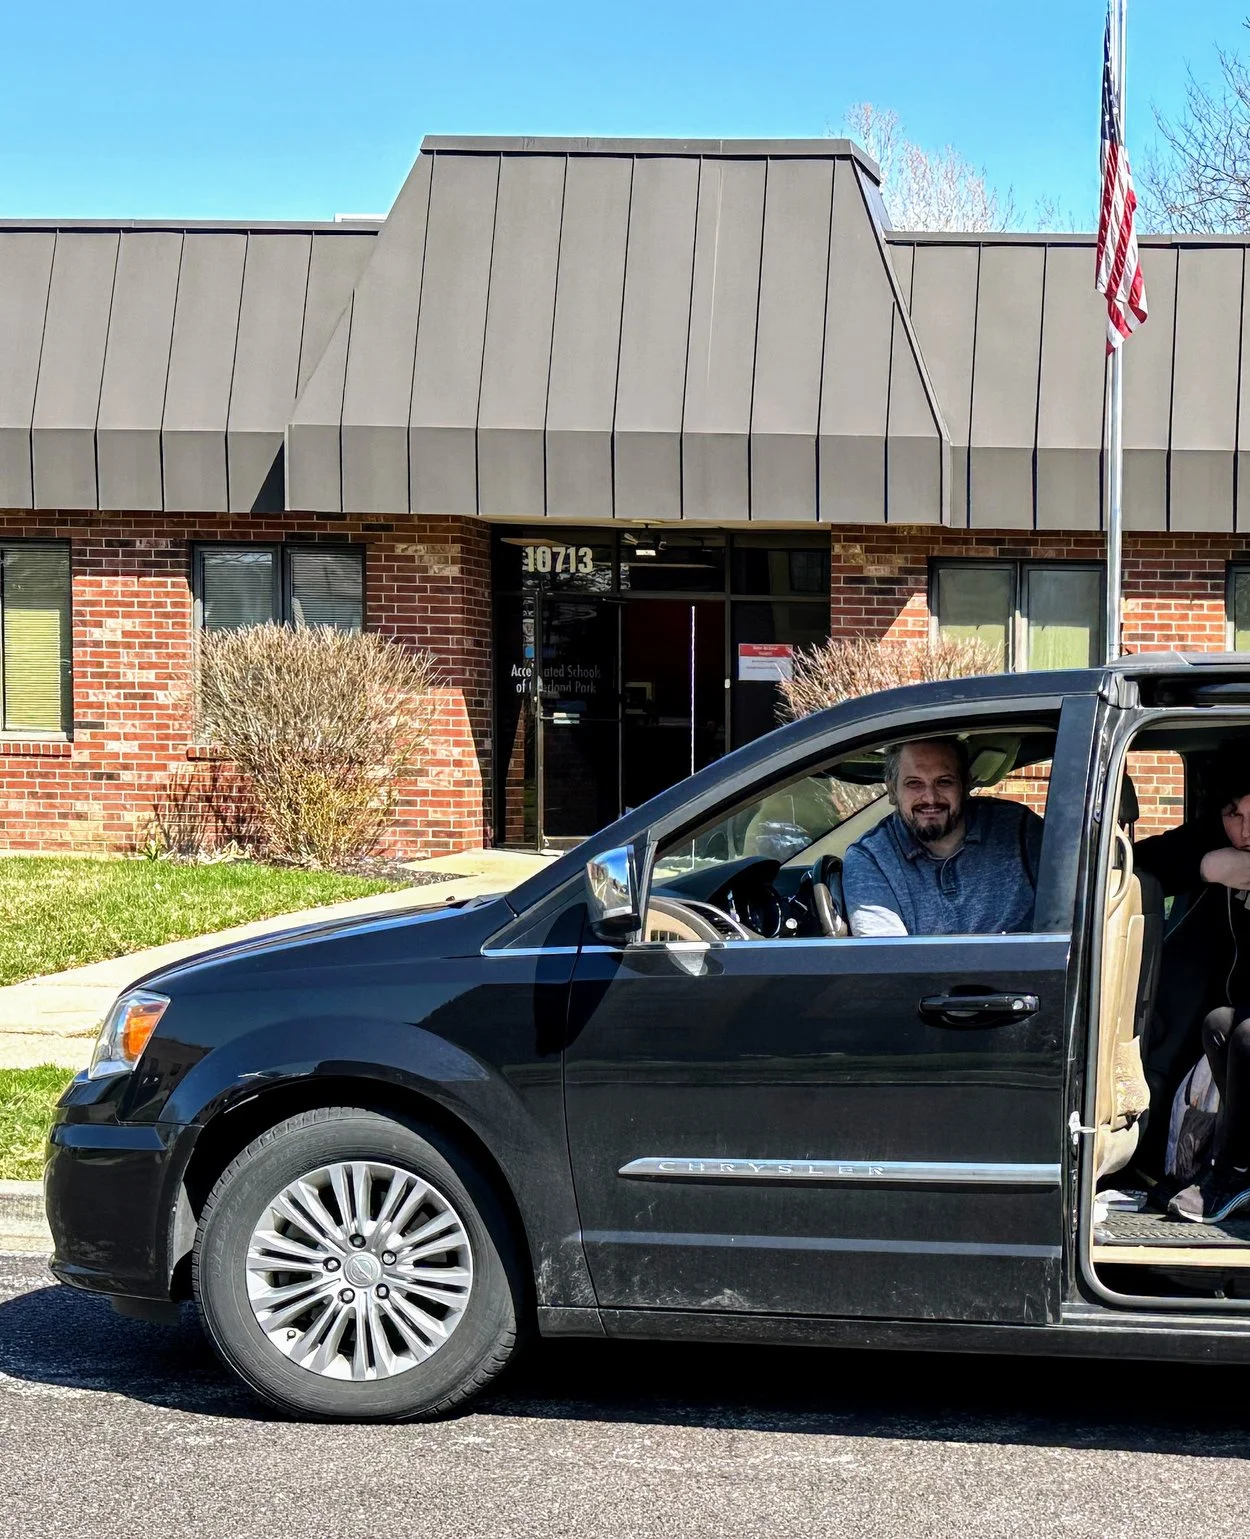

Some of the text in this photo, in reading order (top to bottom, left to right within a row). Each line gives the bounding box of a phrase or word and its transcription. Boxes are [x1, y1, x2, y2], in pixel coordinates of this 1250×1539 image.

[525, 546, 593, 573] 10713
[511, 663, 601, 678] Acceated Schools
[516, 678, 597, 694] of erland Park
[658, 1161, 887, 1176] CHRYSLER
